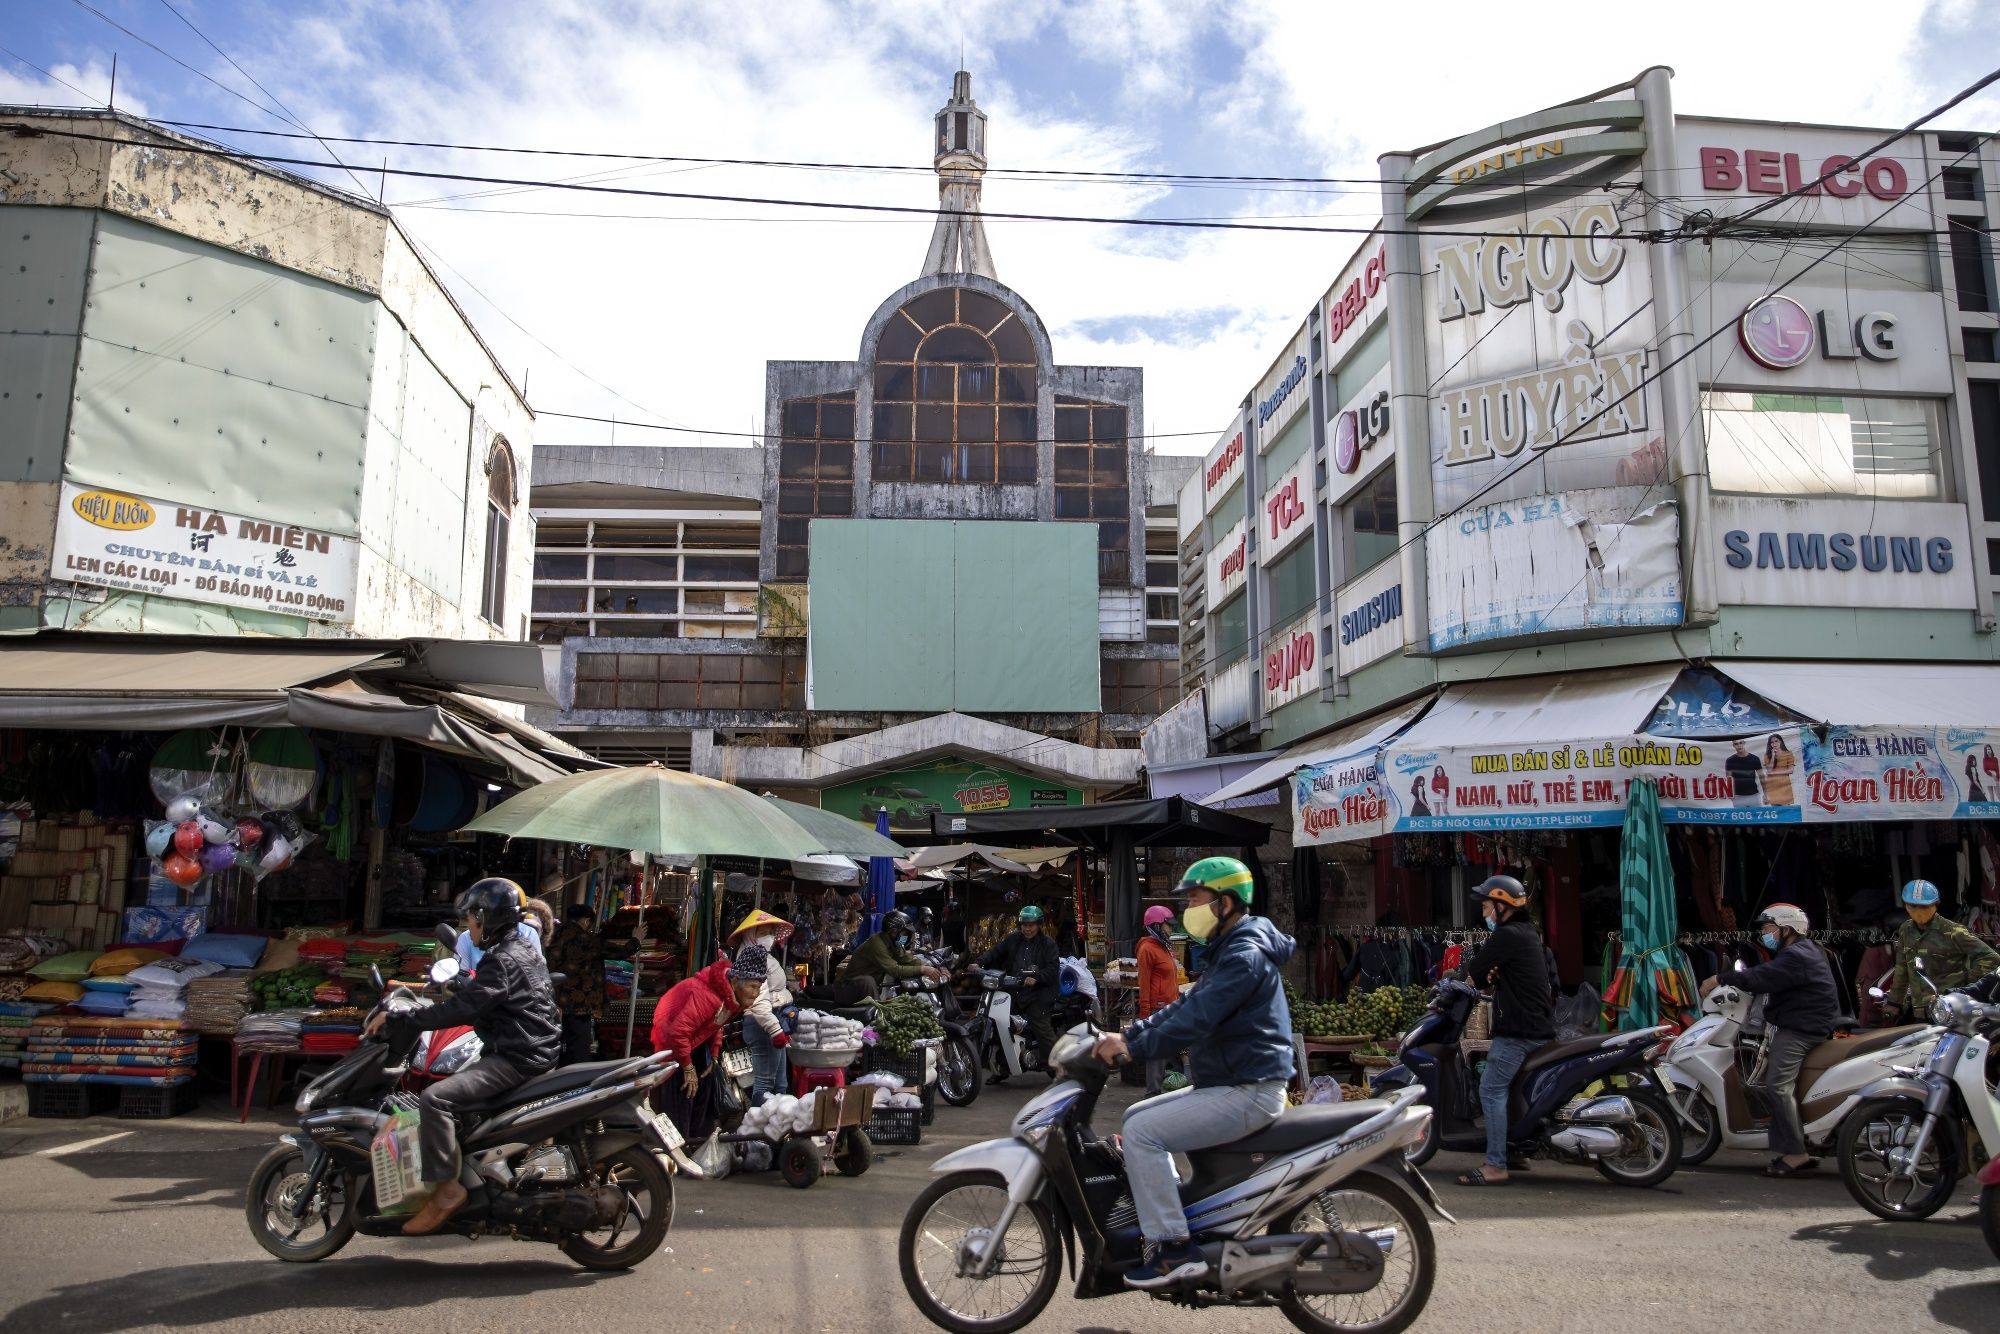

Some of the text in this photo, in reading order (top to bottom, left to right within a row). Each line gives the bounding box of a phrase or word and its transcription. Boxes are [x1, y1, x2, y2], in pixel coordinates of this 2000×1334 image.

[1451, 140, 1562, 184] DNTN
[1700, 146, 1908, 201] BELCO
[1436, 201, 1627, 324] NGỌC
[1818, 310, 1902, 361] LG
[1258, 356, 1306, 428] Panasonic
[1440, 318, 1648, 466] HUYỀN
[1359, 390, 1390, 450] LG
[1206, 432, 1243, 492] HITACHI
[80, 495, 150, 524] HIỆU BUÔN
[1268, 476, 1304, 540] TCL
[105, 543, 196, 568] CHUYÊN
[199, 558, 242, 576] BÁN
[267, 569, 290, 584] VÀ
[1724, 529, 1954, 573] SAMSUNG
[66, 554, 101, 573] LEN
[103, 560, 138, 578] CÁC
[141, 567, 178, 586] LOẠI
[220, 578, 250, 597] BẢO
[253, 585, 274, 602] HỘ
[276, 590, 304, 605] LAO
[306, 594, 344, 612] ĐỘNG
[1341, 584, 1402, 645] SAMSUN
[1660, 608, 1678, 618] 746
[1267, 630, 1315, 692] SANYO
[1472, 741, 1702, 774] MUA BÁN SỈ & LẺ QUẦN ÁO
[1833, 733, 1928, 758] CỬA HÀNG
[953, 784, 1010, 807] 1055
[1338, 766, 1376, 787] HÀNG
[1456, 784, 1502, 808] NAM,
[1507, 779, 1538, 807] NỮ,
[1543, 775, 1578, 804] TRẺ
[1582, 778, 1620, 804] EM,
[1693, 773, 1734, 800] LỚN
[1806, 761, 1944, 814] Loan Hiền
[1302, 787, 1388, 838] Loan Hiền
[1410, 819, 1428, 828] ĐC:
[1446, 818, 1470, 828] NGÔ
[1472, 818, 1491, 827] GIA
[1494, 817, 1508, 828] TỰ
[1510, 816, 1532, 828] (A2)
[1536, 814, 1592, 825] TP.PLEIKU
[1678, 810, 1778, 820] ĐT: 0987 606 746
[1969, 806, 1998, 814] ĐC: 56
[1084, 1174, 1116, 1183] HONDA
